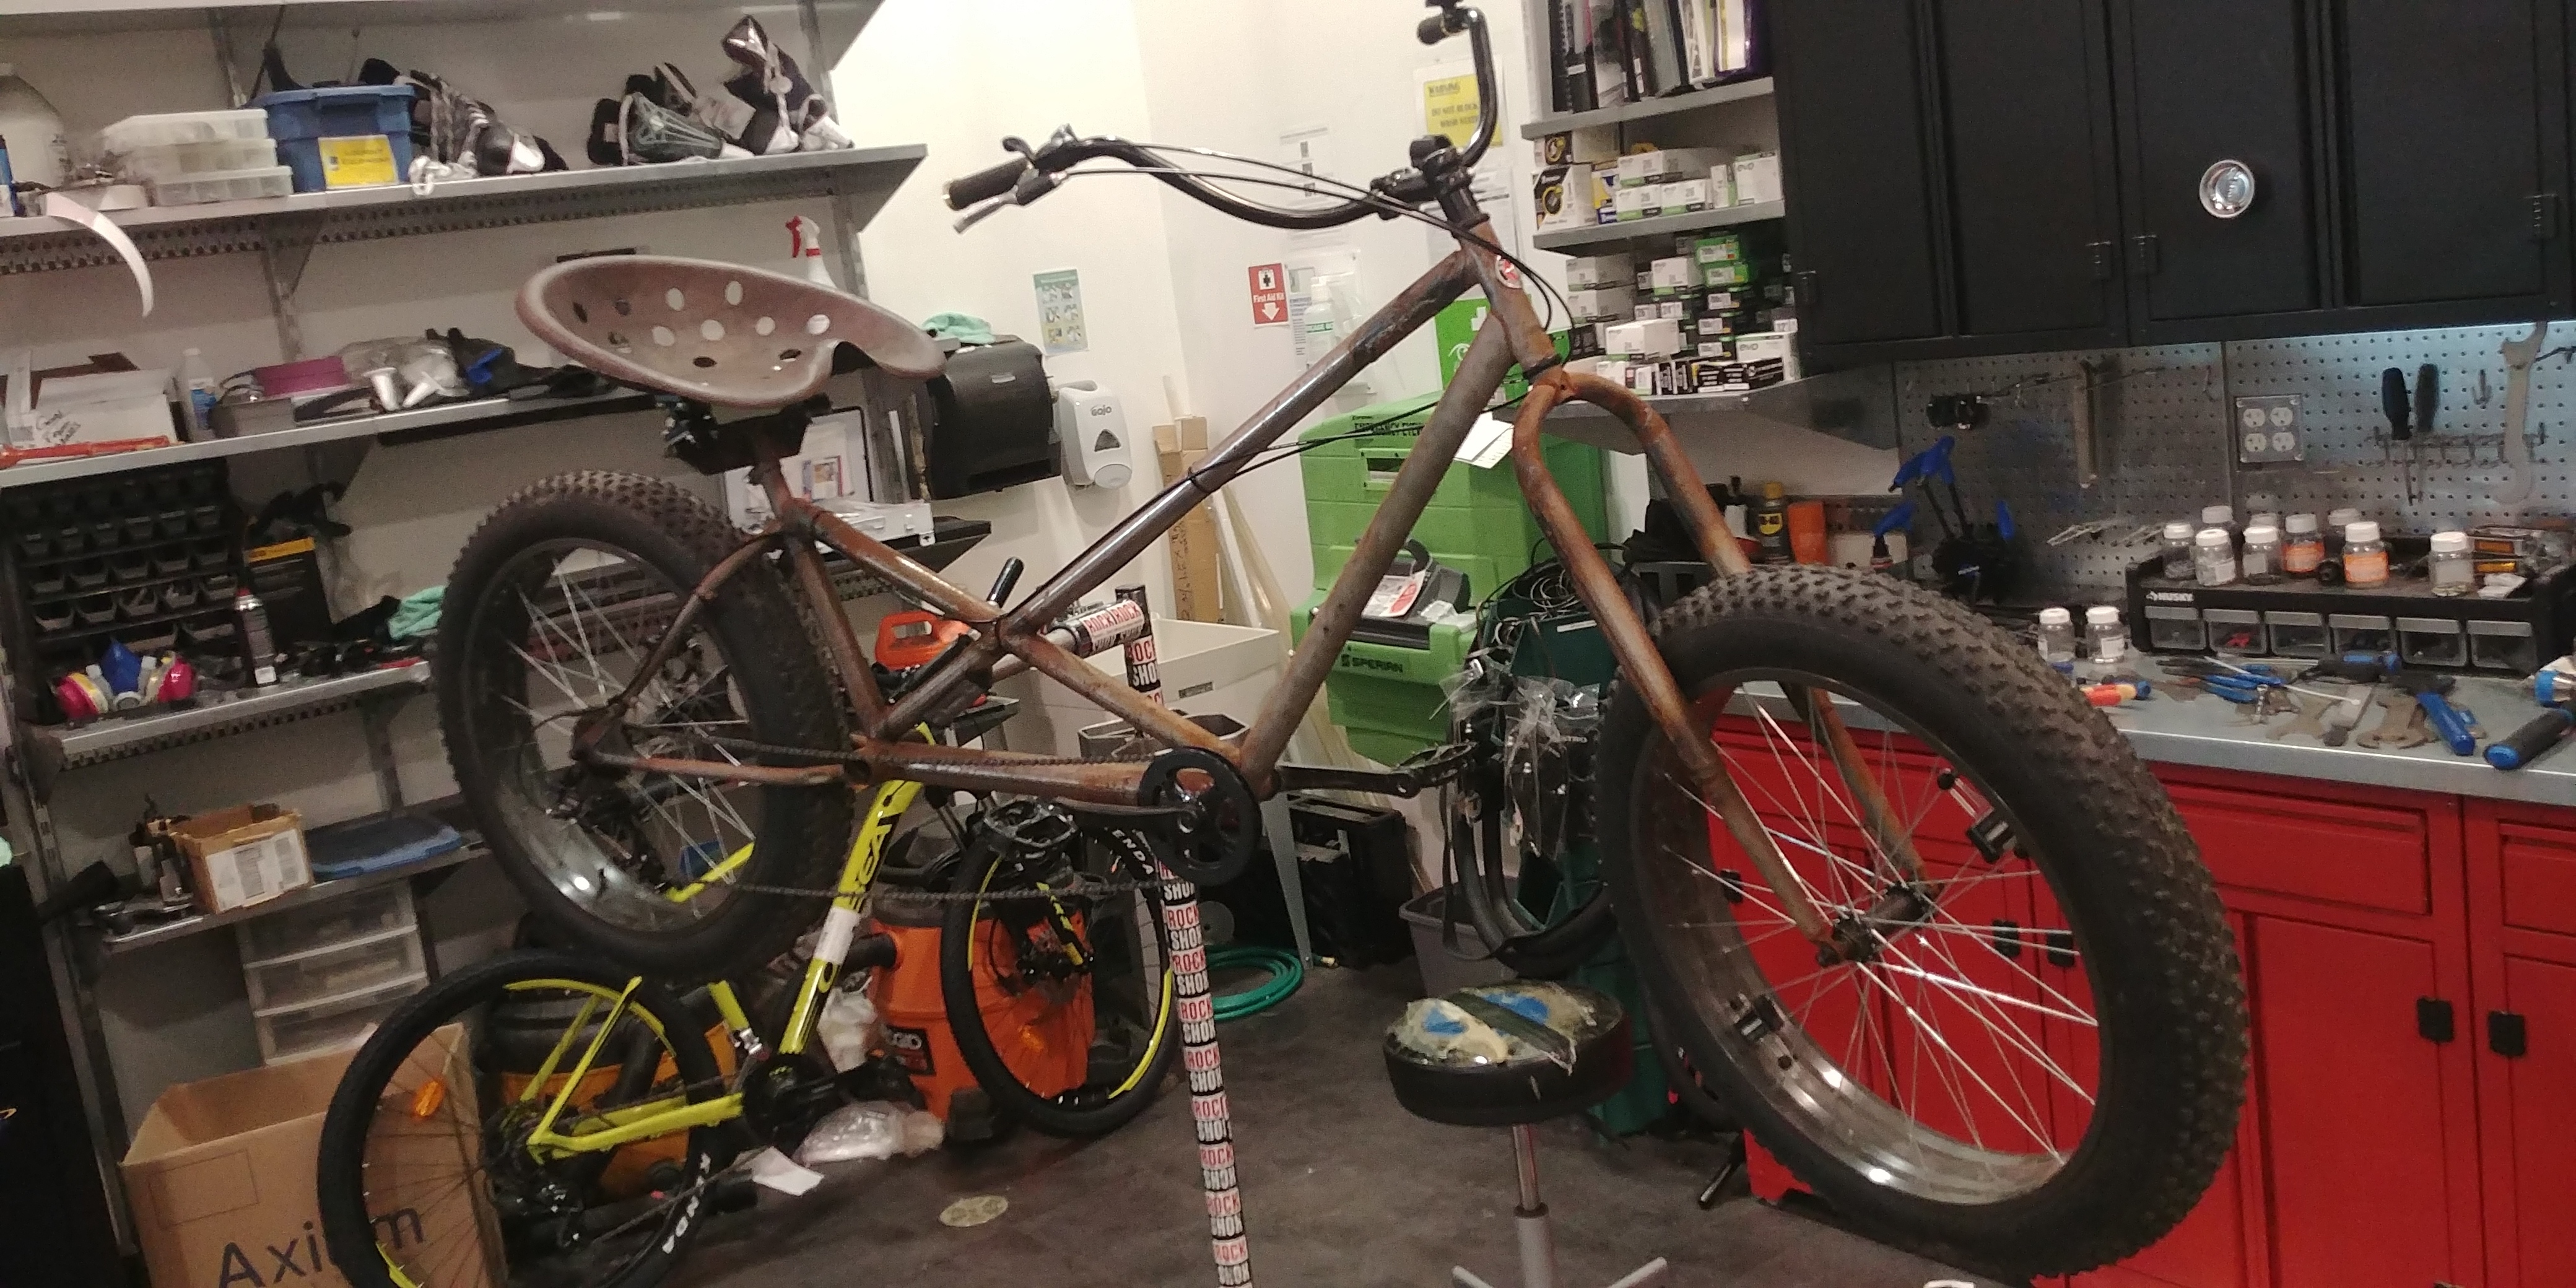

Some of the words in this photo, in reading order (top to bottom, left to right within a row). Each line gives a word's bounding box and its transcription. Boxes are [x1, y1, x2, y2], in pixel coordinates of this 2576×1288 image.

[1739, 343, 1759, 352] evo
[2157, 592, 2194, 602] HUSKY
[1128, 640, 1155, 664] ROC
[1133, 662, 1158, 687] SHO
[1112, 829, 1154, 875] ENDA
[219, 1208, 424, 1288] Axim
